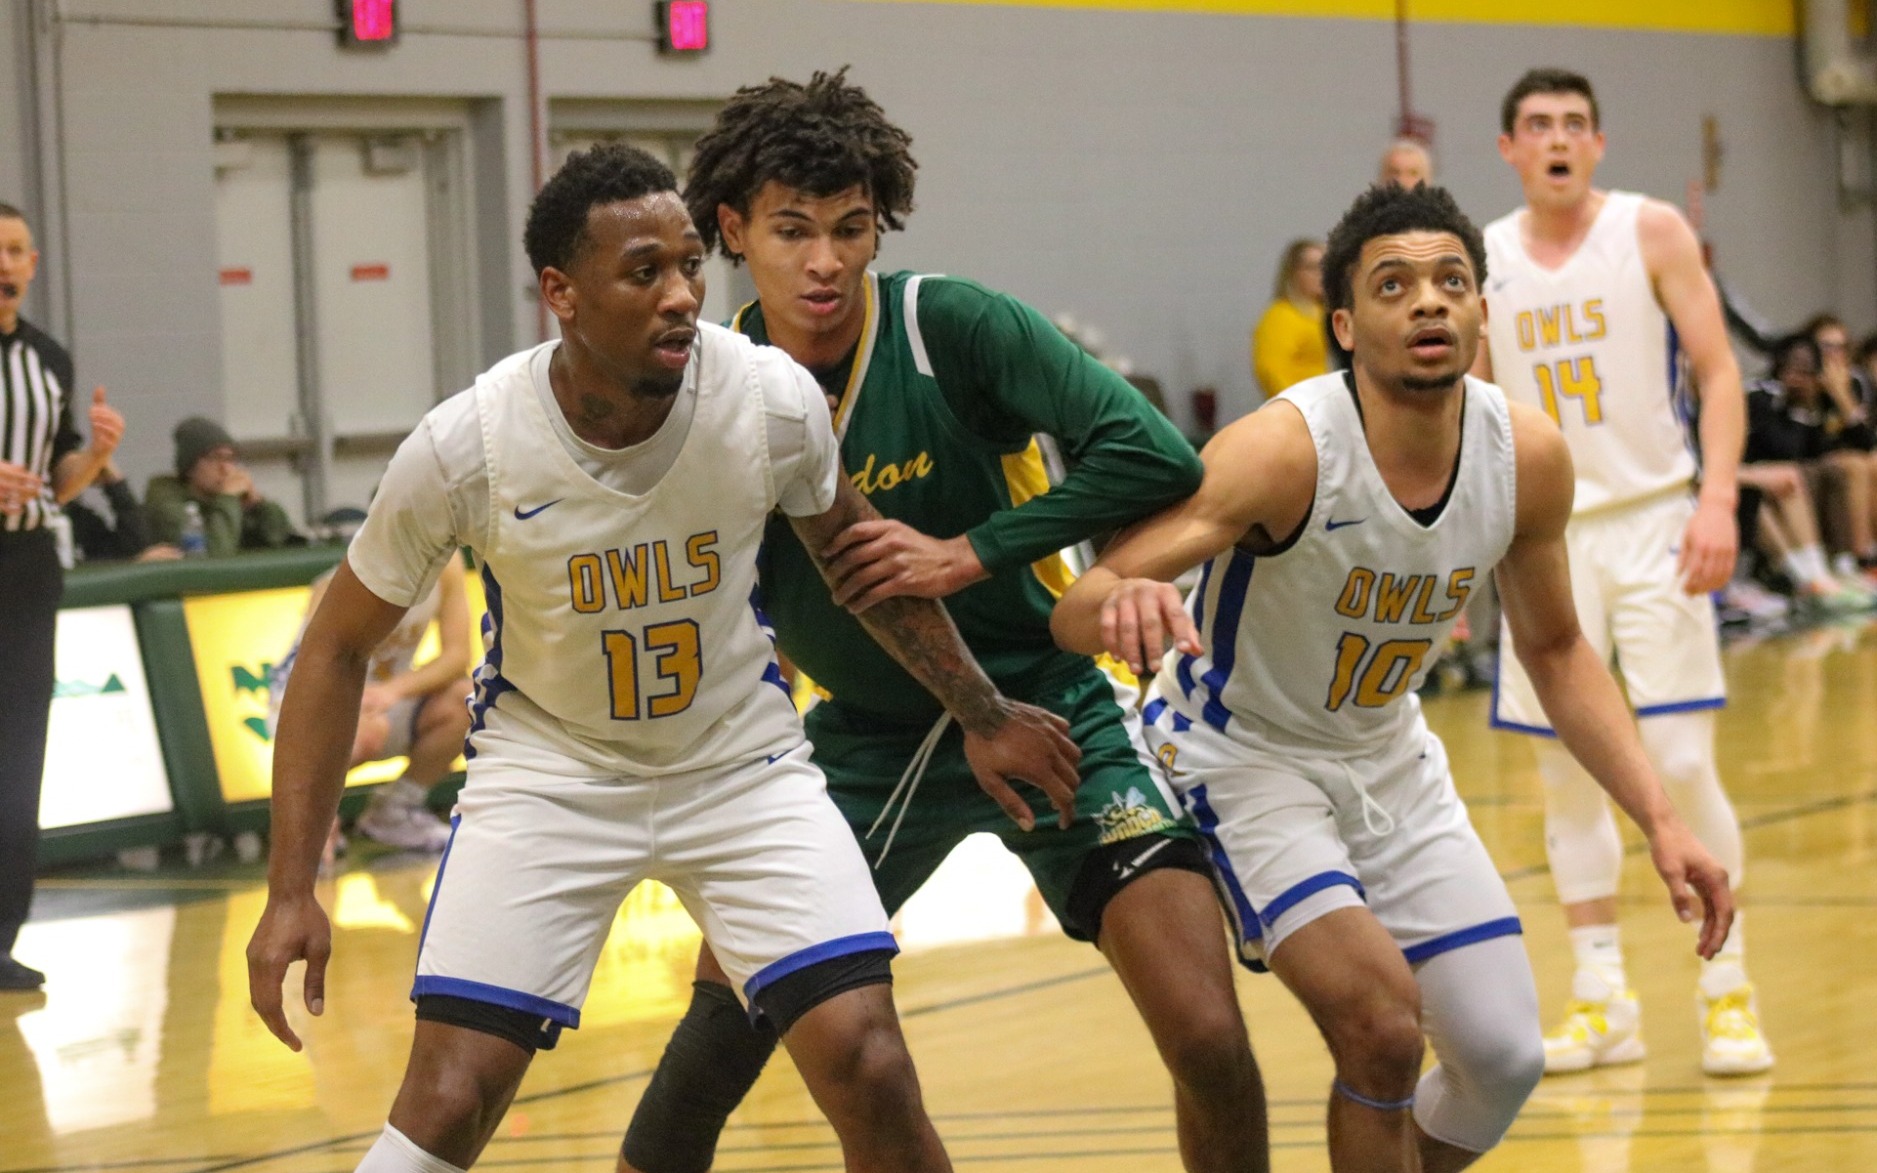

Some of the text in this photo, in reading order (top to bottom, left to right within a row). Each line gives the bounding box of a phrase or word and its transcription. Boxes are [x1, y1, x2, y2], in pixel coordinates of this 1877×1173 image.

[1515, 298, 1607, 352] OWLS
[1533, 355, 1604, 430] 14
[568, 530, 721, 614] OWLS
[1334, 566, 1475, 624] OWLS
[601, 618, 703, 720] 13
[1324, 631, 1433, 712] 10
